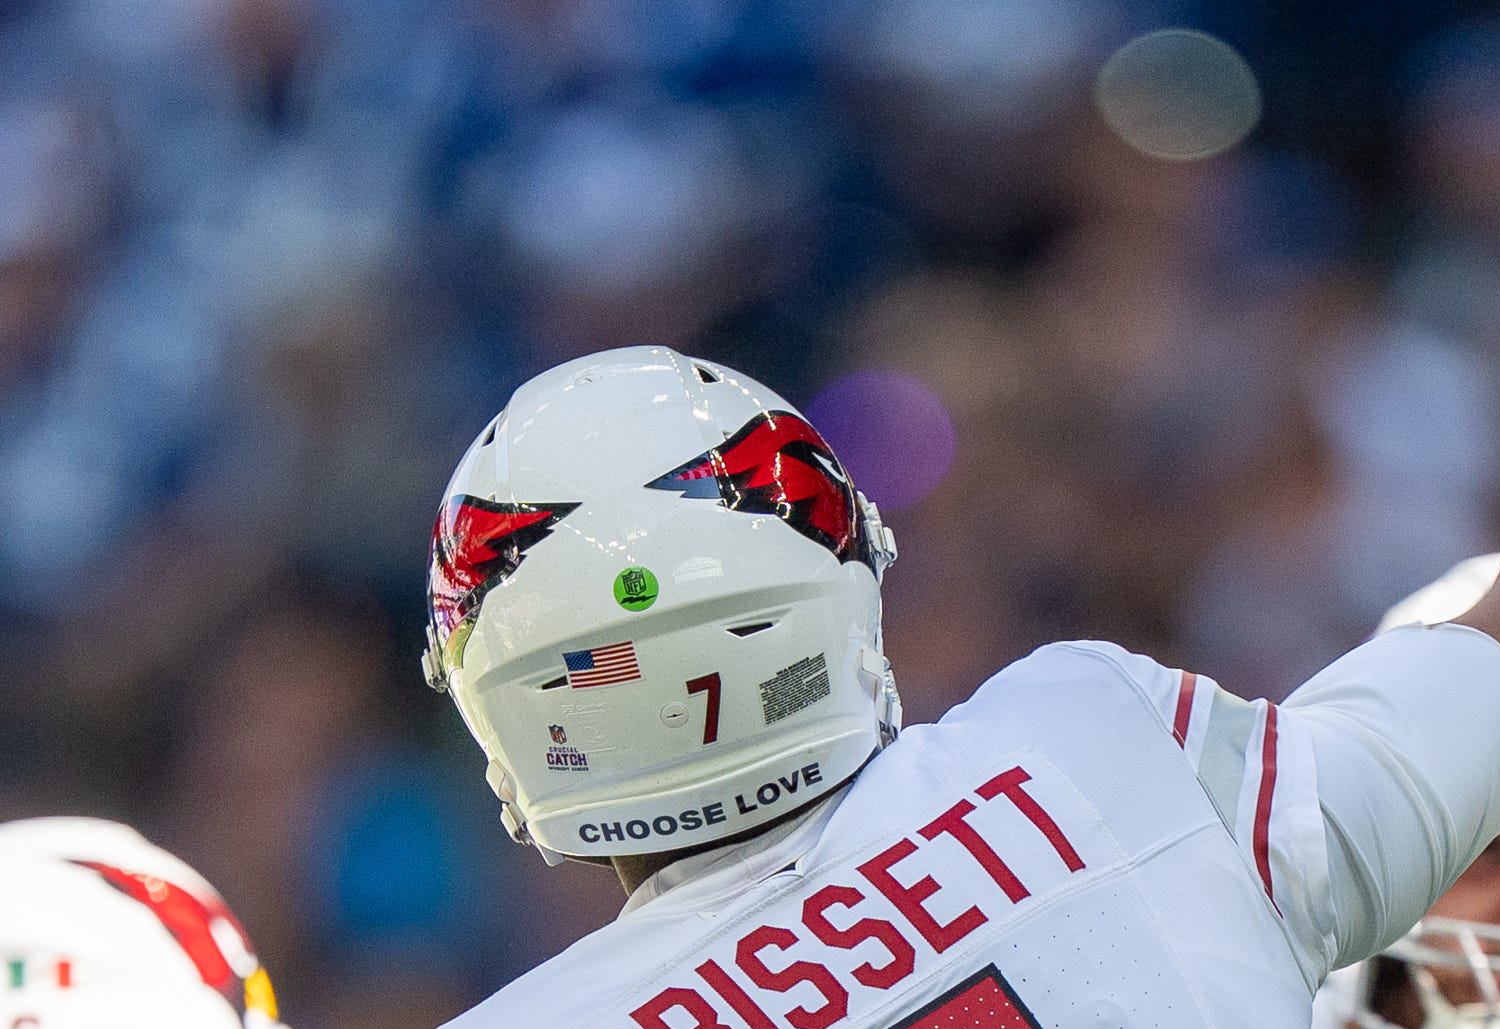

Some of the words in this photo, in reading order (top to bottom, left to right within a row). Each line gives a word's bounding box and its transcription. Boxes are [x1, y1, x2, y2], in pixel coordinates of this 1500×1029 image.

[685, 671, 722, 745] 7
[546, 753, 587, 766] CATCH
[579, 802, 727, 843] CHOOSE
[735, 762, 823, 815] LOVE
